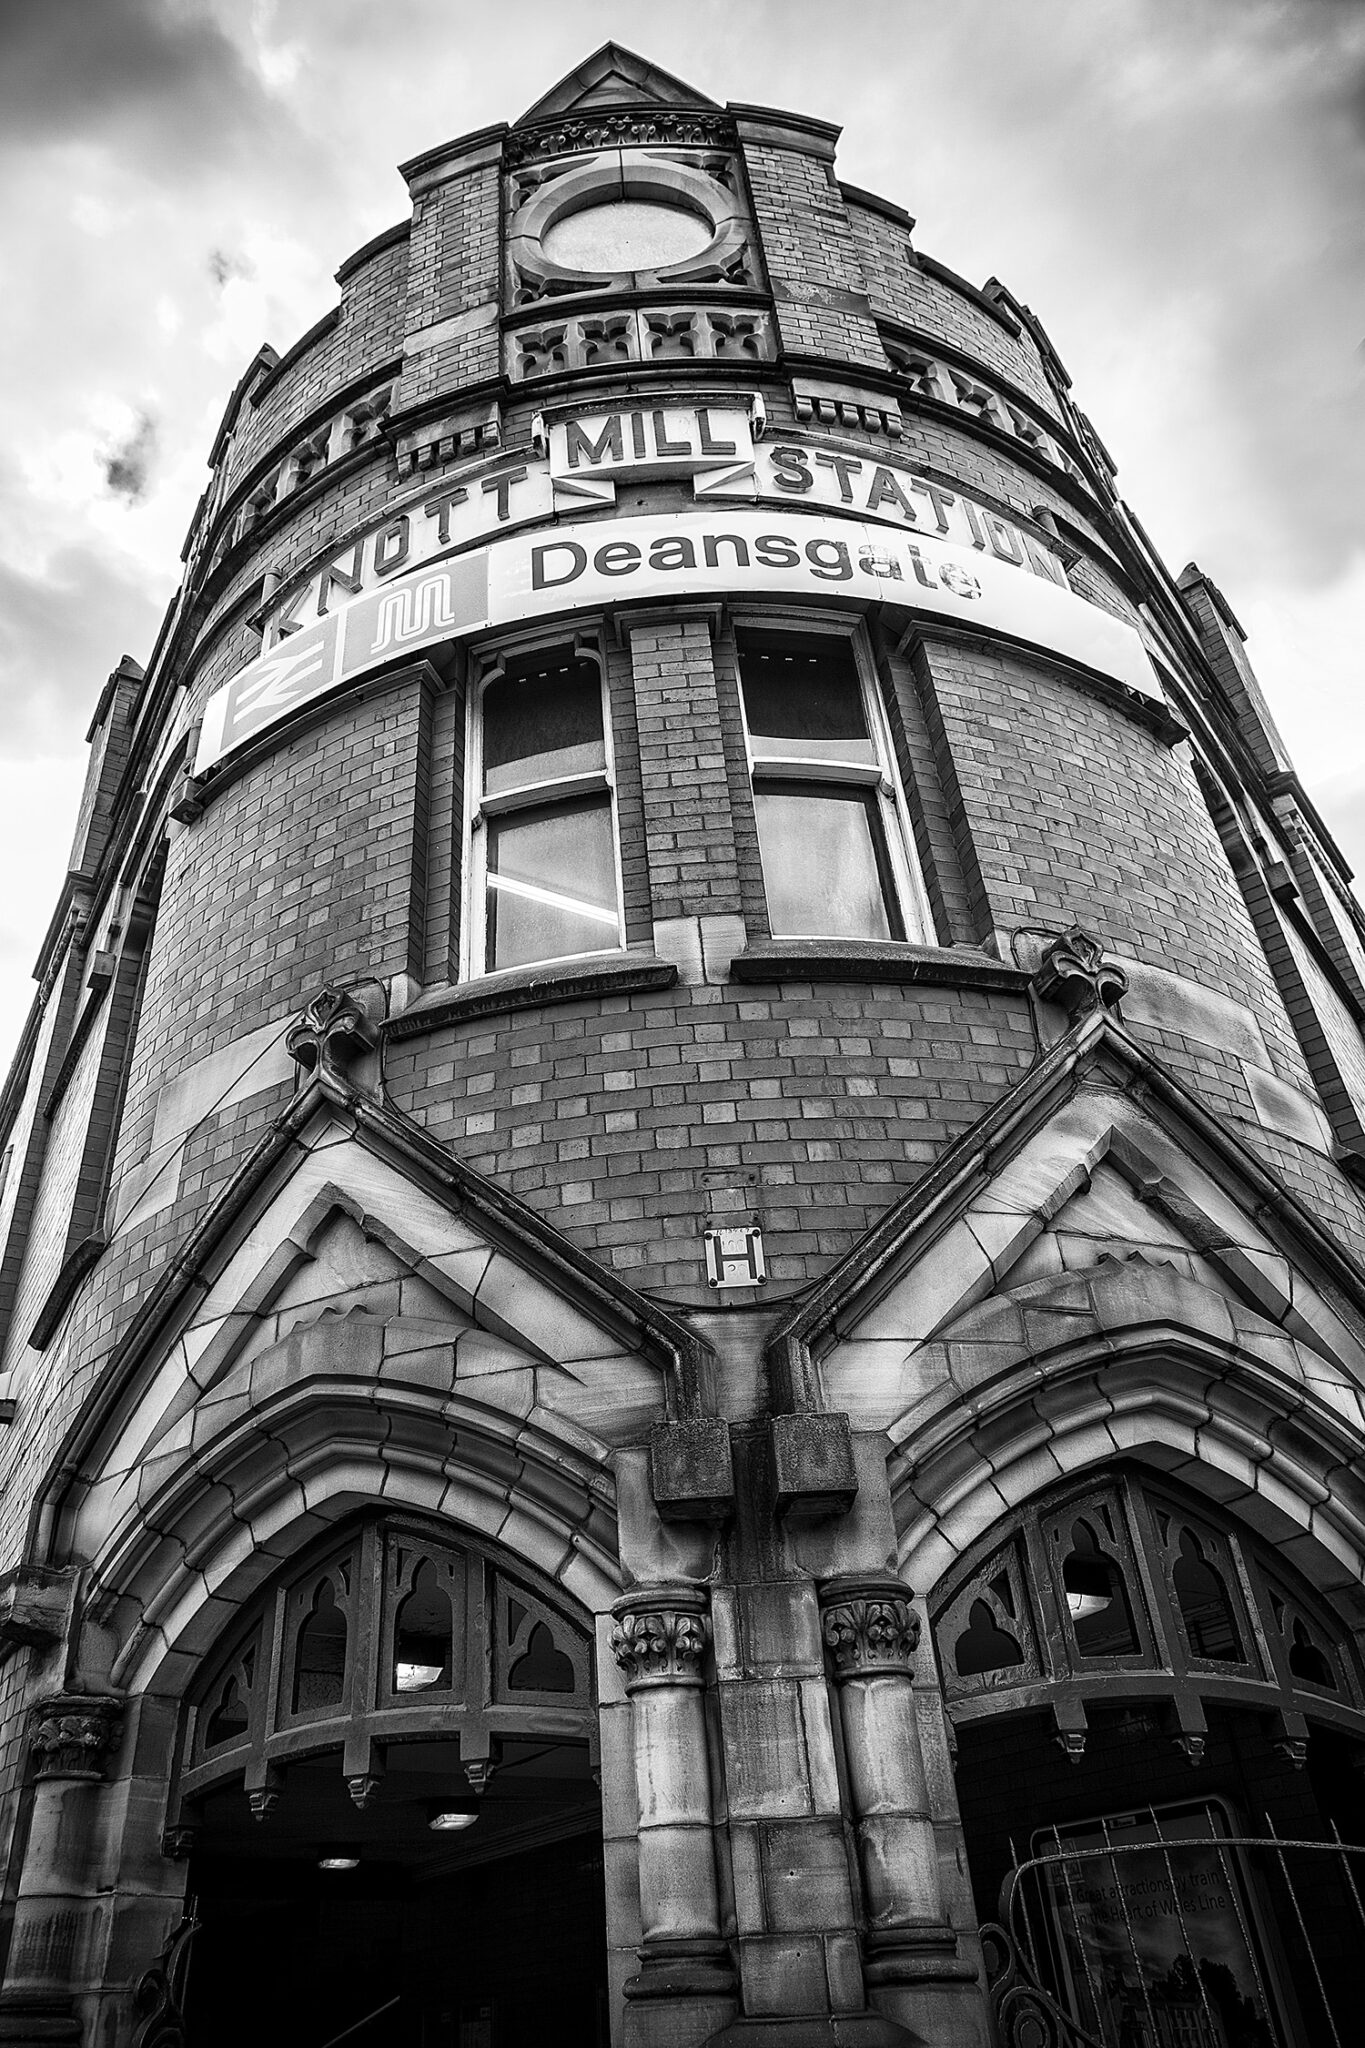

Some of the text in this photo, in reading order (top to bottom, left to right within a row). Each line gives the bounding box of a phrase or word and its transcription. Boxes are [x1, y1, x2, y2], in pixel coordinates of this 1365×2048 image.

[269, 409, 1067, 648] KNOTT MILL STATION
[531, 534, 982, 599] Deansgate
[713, 1233, 758, 1282] H
[1077, 1886, 1106, 1904] Great
[1189, 1870, 1220, 1888] train
[1145, 1900, 1158, 1918] of
[1199, 1893, 1226, 1911] Line
